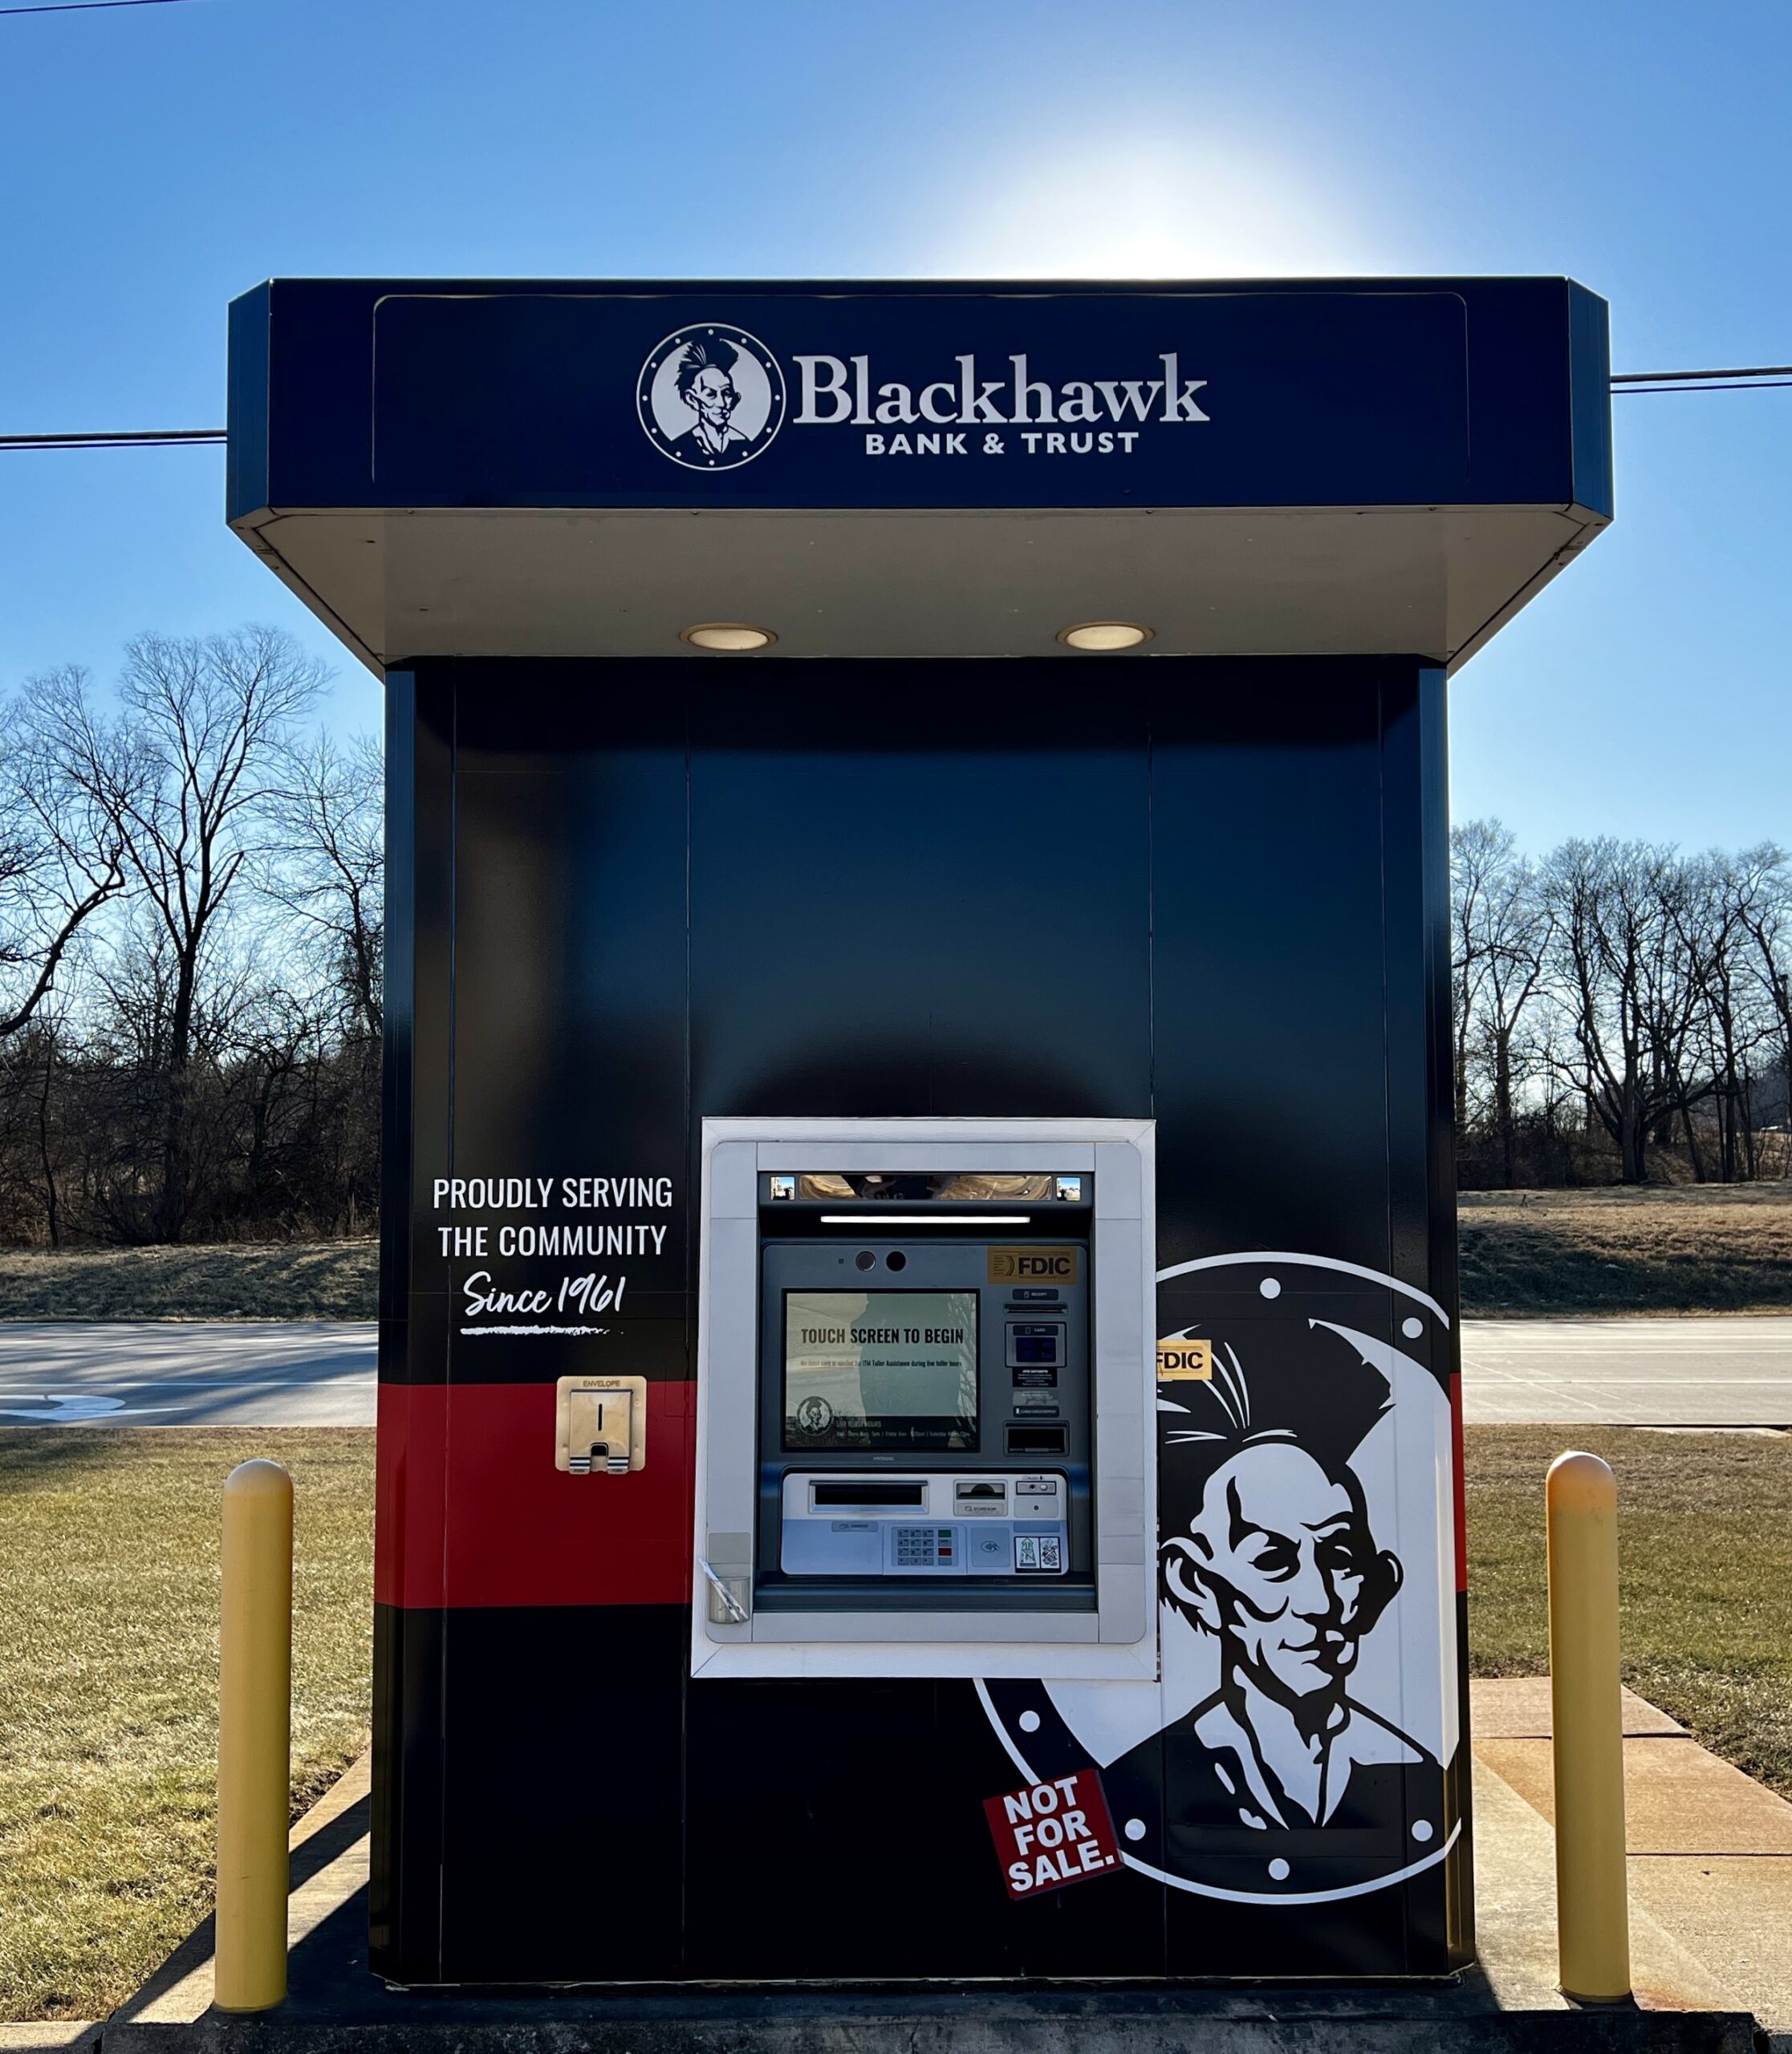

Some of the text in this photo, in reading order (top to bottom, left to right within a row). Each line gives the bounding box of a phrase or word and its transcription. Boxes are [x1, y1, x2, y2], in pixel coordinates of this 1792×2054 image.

[793, 353, 1210, 424] Blackhawk
[866, 432, 1140, 455] BANK & TRUST
[433, 1177, 673, 1209] PROUDLY SERVING
[437, 1225, 667, 1257] THE COMMUNITY
[1018, 1256, 1071, 1276] FDIC
[462, 1271, 626, 1317] Since 1961
[801, 1328, 964, 1344] TOUCH SCREEN TO BEGIN
[1003, 1776, 1078, 1825] NOT
[1014, 1809, 1092, 1857] FOR
[1008, 1839, 1115, 1892] SALE.
